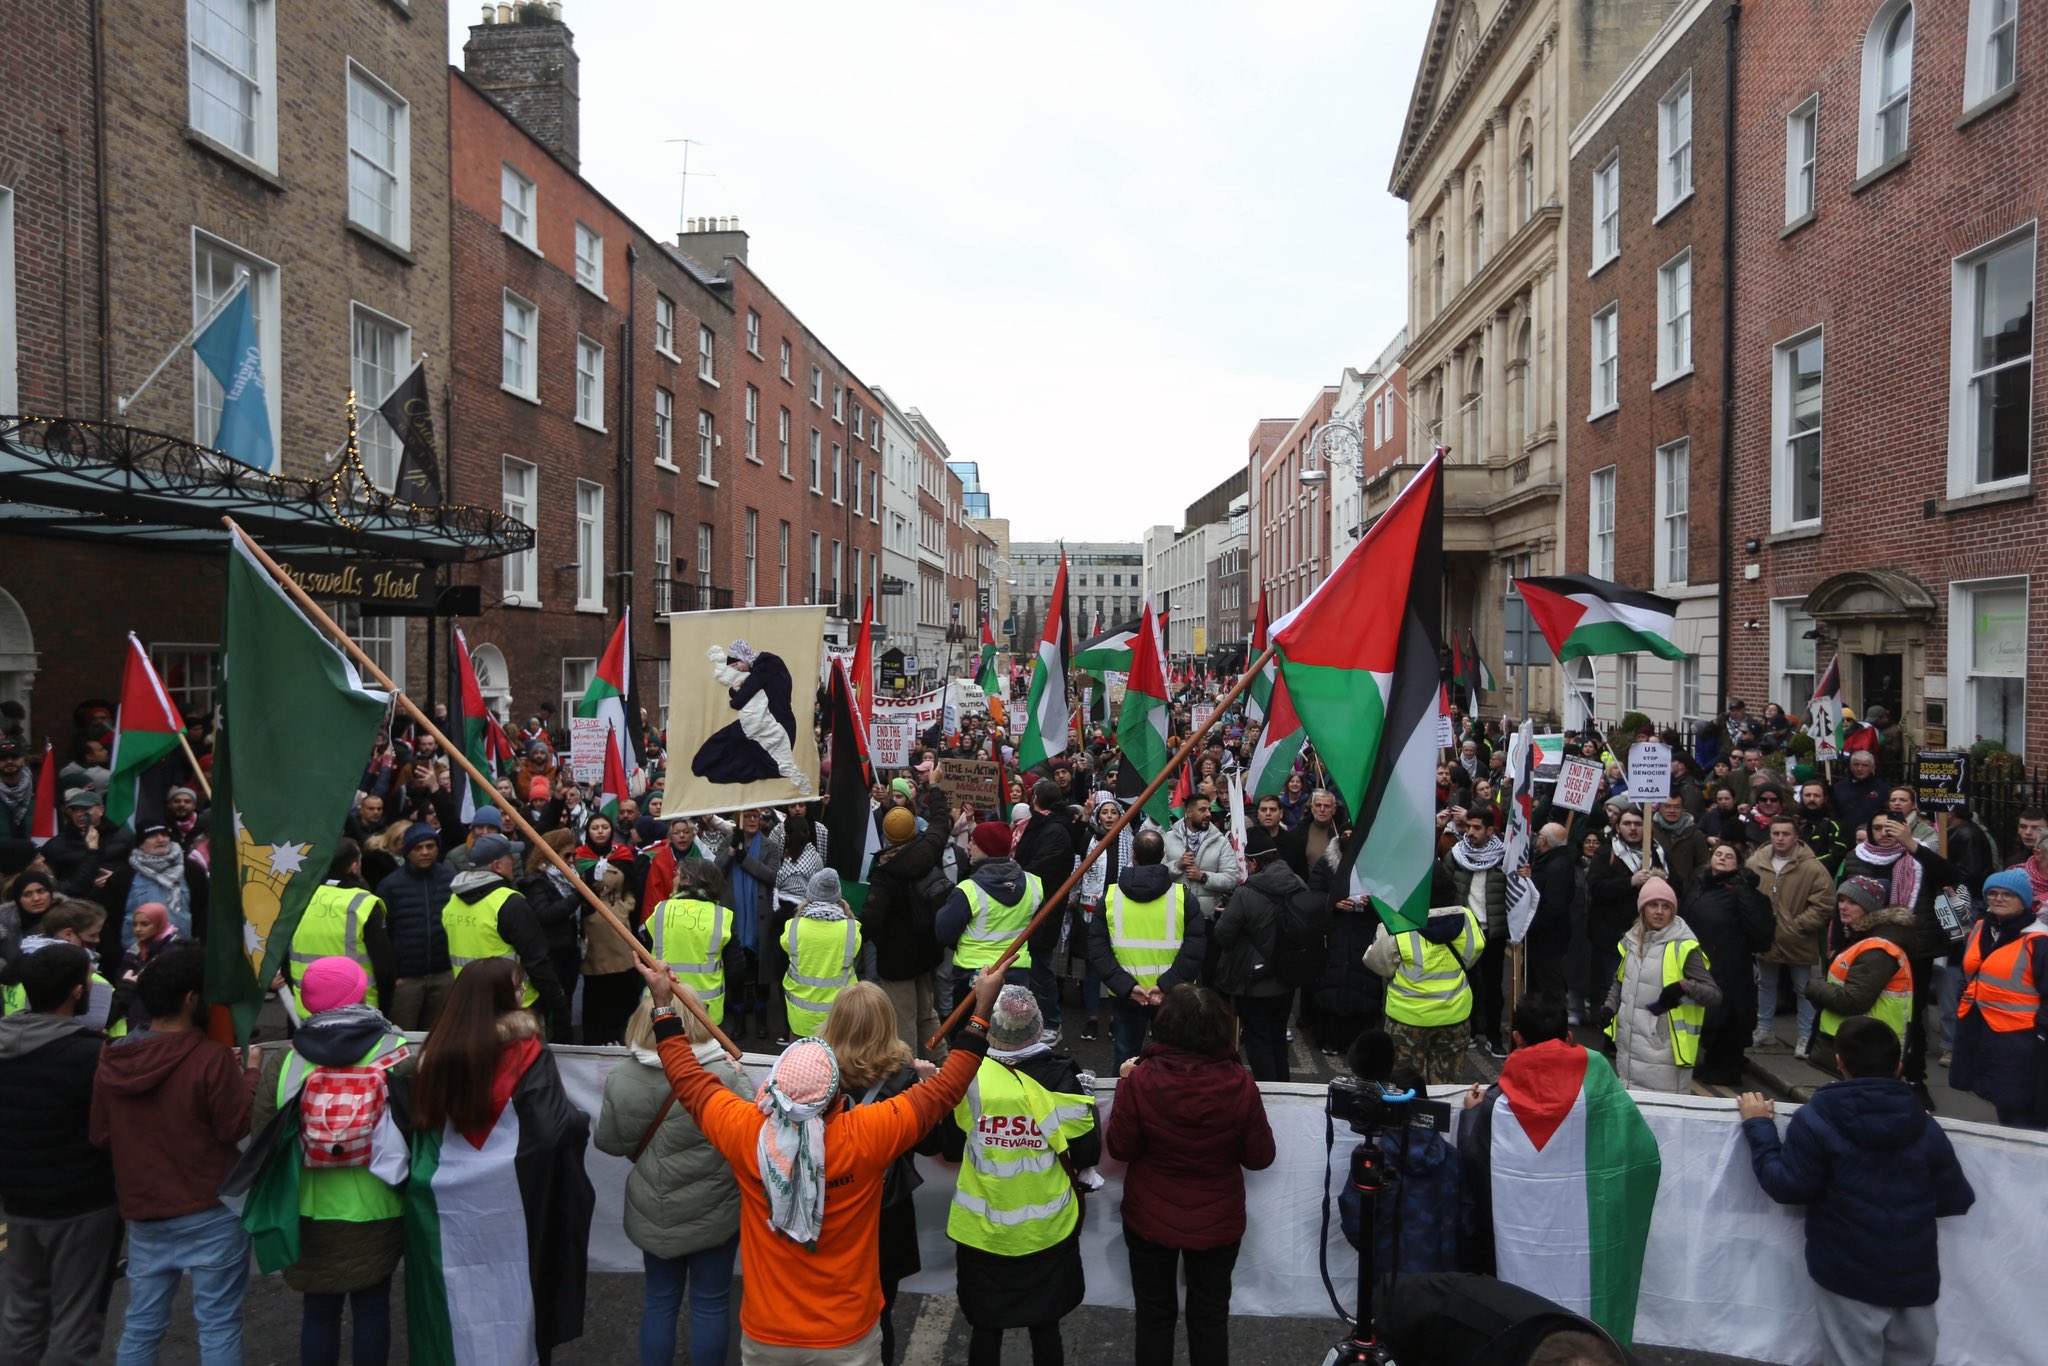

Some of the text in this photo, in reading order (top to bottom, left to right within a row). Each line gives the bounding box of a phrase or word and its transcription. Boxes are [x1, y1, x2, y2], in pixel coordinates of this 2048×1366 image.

[278, 563, 421, 599] Buswells Hotel
[873, 694, 936, 707] OYCOTT
[877, 725, 888, 738] END
[890, 725, 900, 738] THE
[877, 739, 901, 750] SIEGE OF
[881, 752, 898, 764] GAZA!
[943, 762, 961, 773] TIME
[974, 764, 998, 776] ACTION
[1568, 763, 1595, 780] END THE
[1564, 776, 1592, 793] SIEGE OF
[1564, 790, 1584, 805] GAZA!
[665, 904, 706, 931] IPSC
[985, 1137, 1042, 1148] STEWARD
